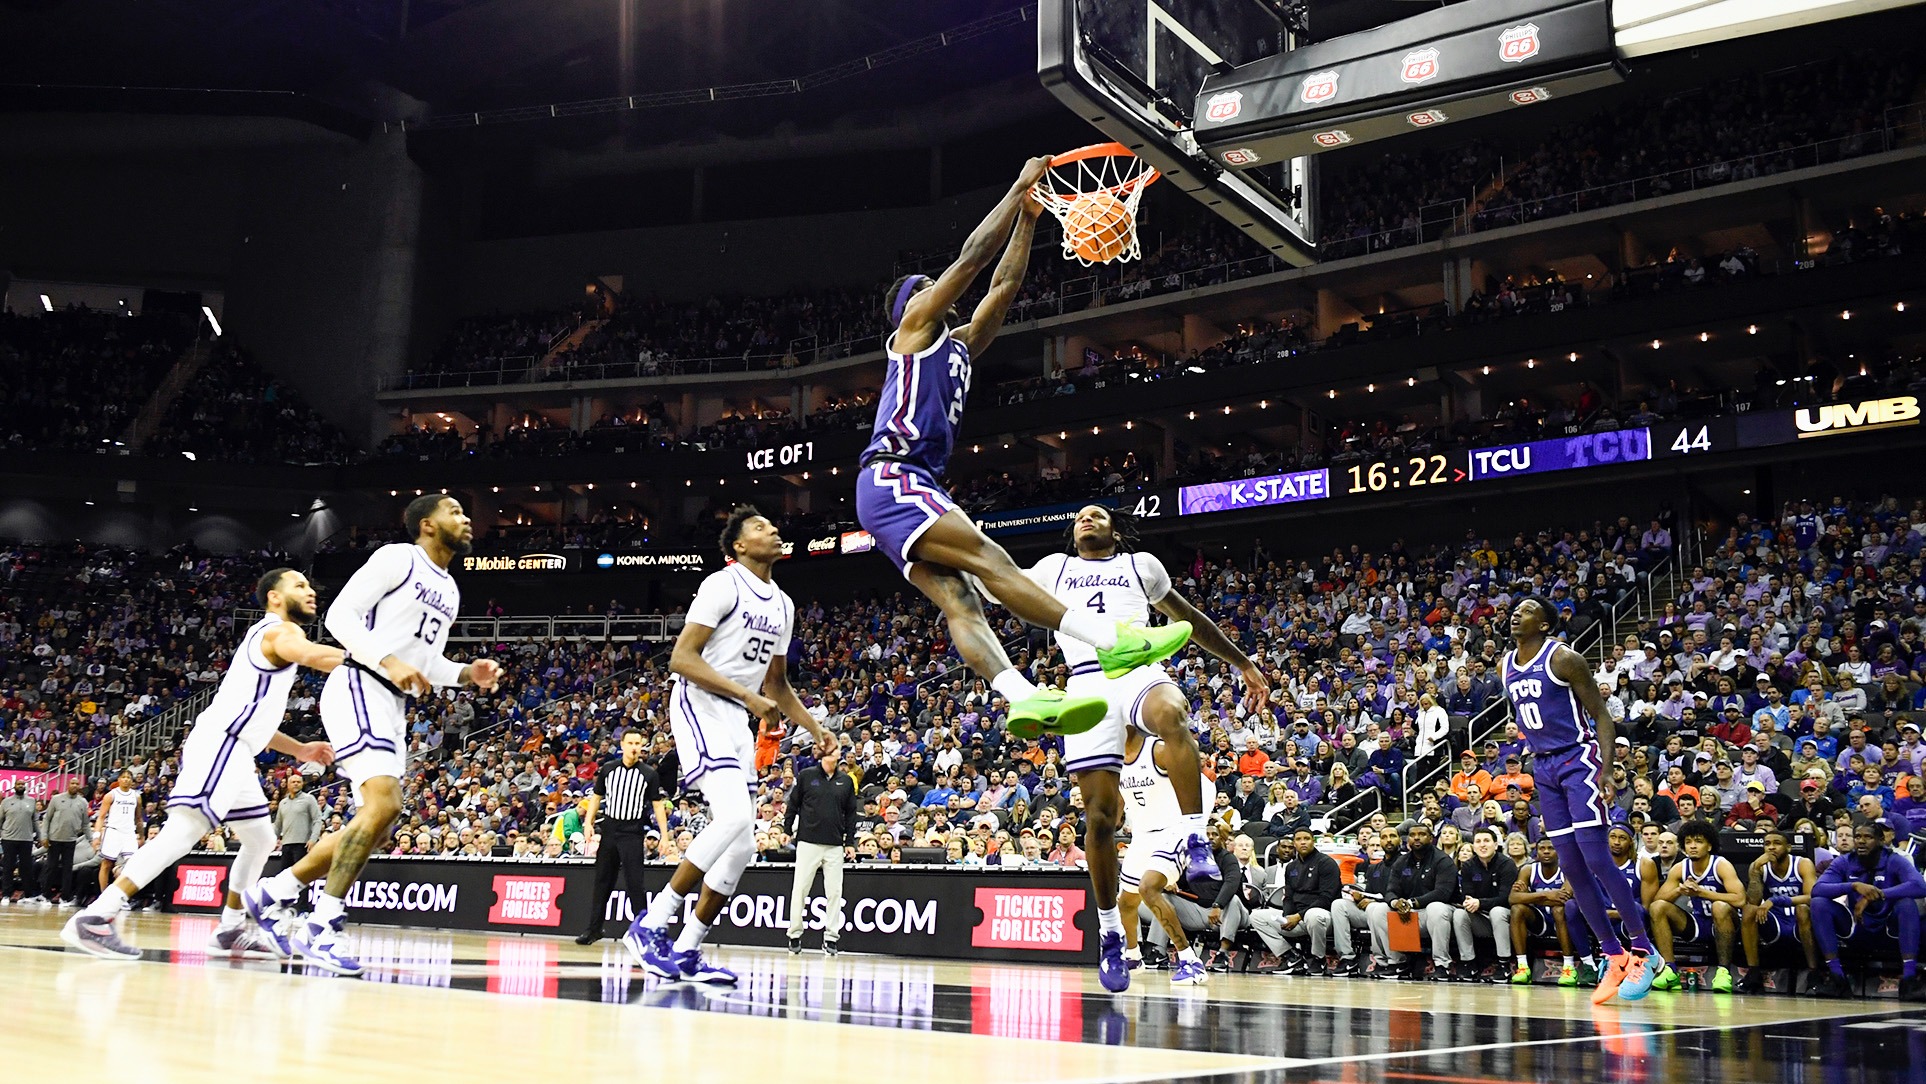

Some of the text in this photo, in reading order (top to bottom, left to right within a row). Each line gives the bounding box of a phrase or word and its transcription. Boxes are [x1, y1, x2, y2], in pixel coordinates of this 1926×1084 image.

[1505, 28, 1533, 41] PHILLIPS
[1507, 38, 1531, 56] 66
[1408, 52, 1434, 63] PHILLIPS
[1408, 61, 1432, 77] 66
[1308, 83, 1331, 97] 66
[1212, 102, 1236, 117] 66
[1319, 133, 1338, 145] 66
[1227, 151, 1246, 164] 66
[1550, 303, 1564, 312] 209
[947, 387, 963, 425] 2
[1795, 396, 1921, 432] UMB
[1564, 425, 1578, 434] 106
[1671, 424, 1711, 454] 44
[780, 443, 803, 465] OF
[1475, 428, 1647, 474] TCU TCU
[1348, 454, 1447, 493] 16:22
[1231, 473, 1324, 505] K-STATE
[1132, 494, 1162, 518] 42
[984, 521, 997, 530] THE
[997, 516, 1033, 529] UNIVERSITY
[1033, 516, 1041, 524] OF
[1042, 513, 1066, 523] KANSAS
[1802, 526, 1807, 535] 1
[518, 558, 562, 570] CENTER
[616, 554, 704, 566] KONICA MINOLTA
[1065, 574, 1131, 591] Wildcats
[1086, 591, 1106, 614] 4
[414, 611, 442, 646] 13
[742, 636, 775, 665] 35
[1508, 678, 1543, 703] TCU
[1518, 701, 1544, 730] 10
[1132, 791, 1146, 807] 5
[185, 869, 217, 886] TICKETS
[505, 880, 550, 901] TICKETS
[994, 895, 1064, 919] TICKETS
[1688, 977, 1696, 986] G
